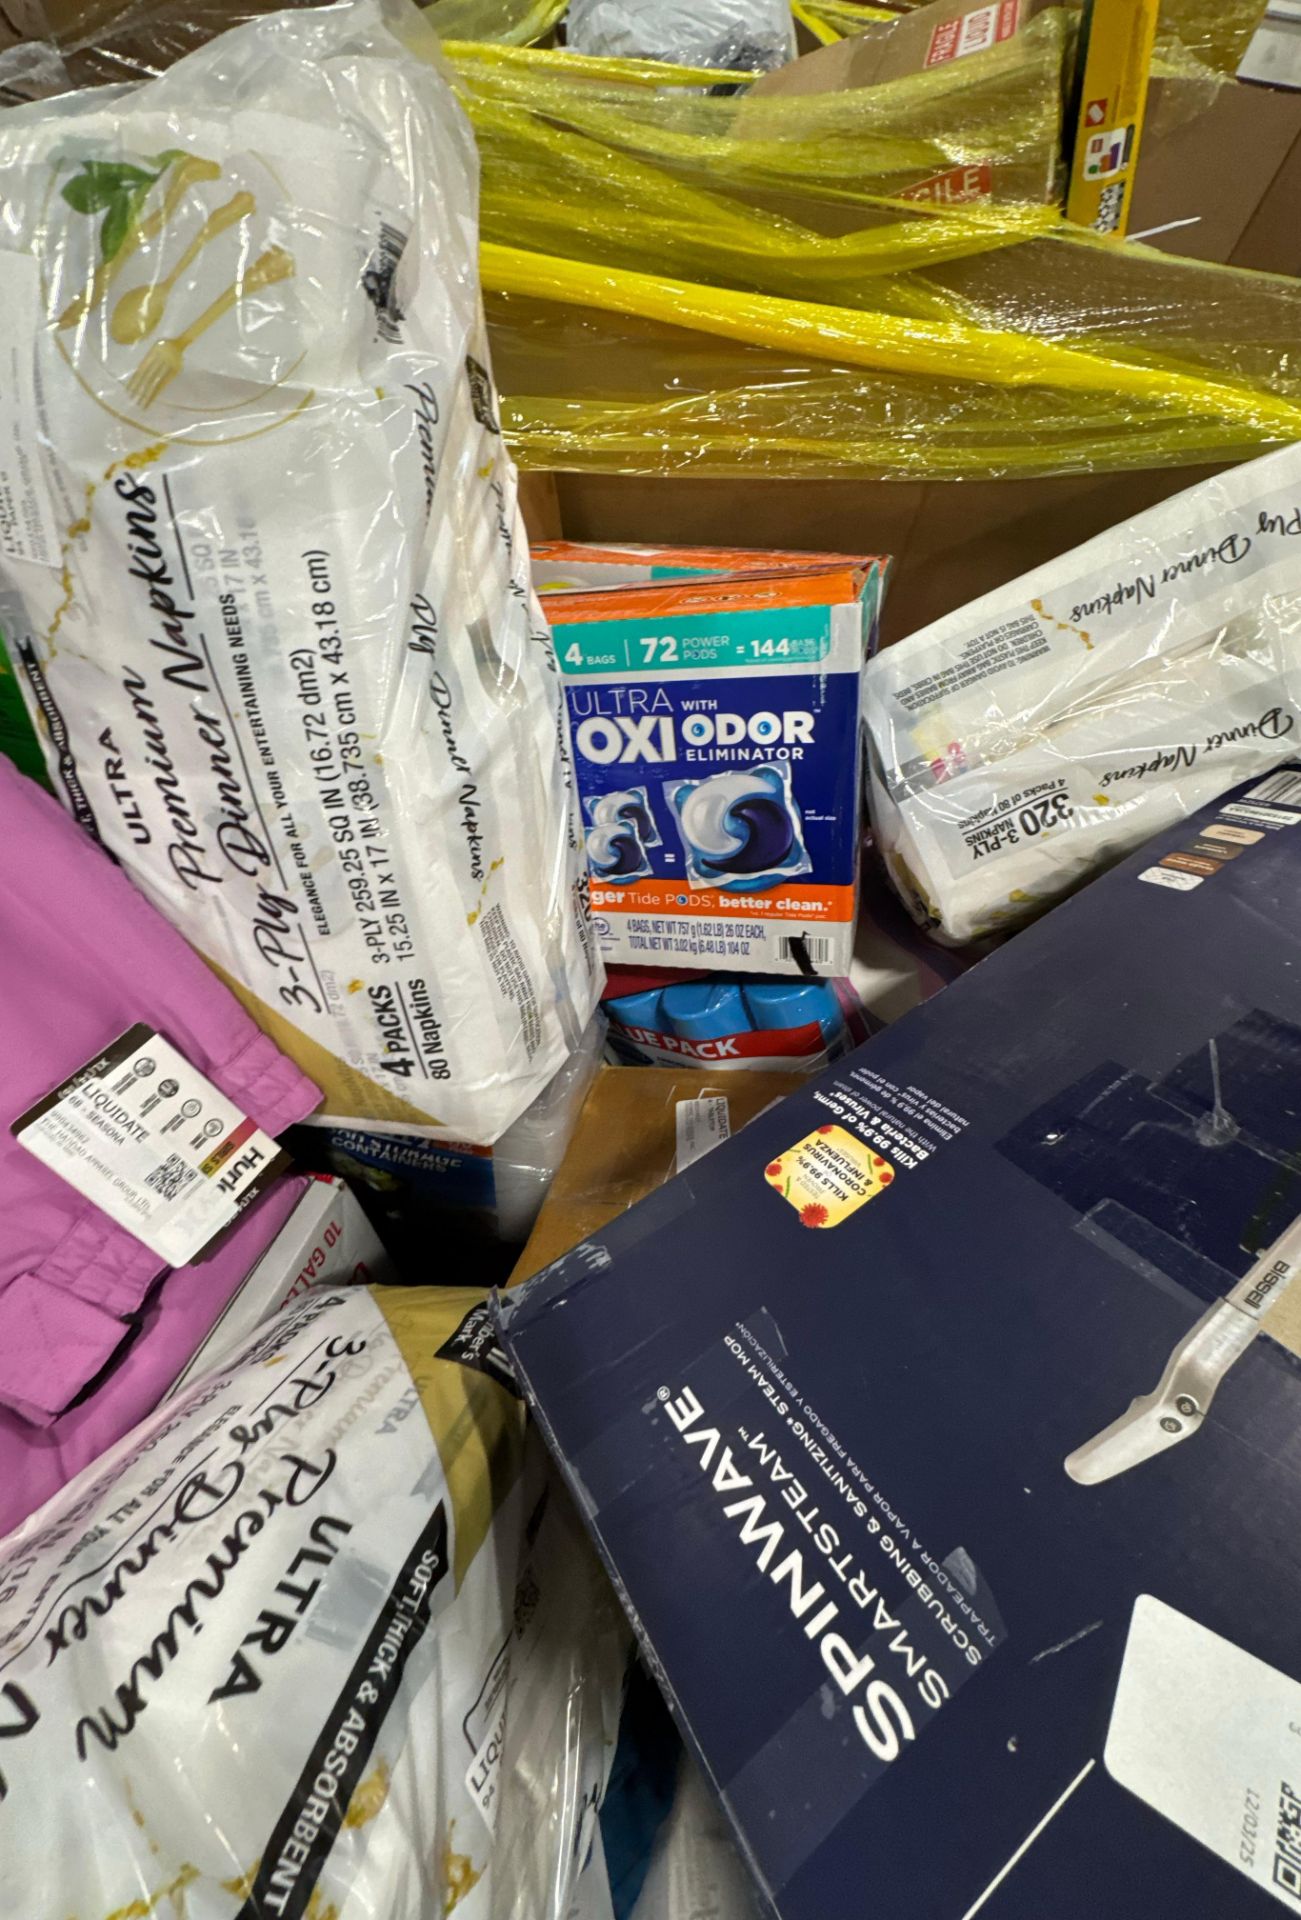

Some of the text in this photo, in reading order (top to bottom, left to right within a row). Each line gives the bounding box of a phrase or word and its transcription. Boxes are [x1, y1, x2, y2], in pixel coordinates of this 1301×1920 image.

[912, 166, 982, 205] GILE
[301, 549, 332, 594] cm)
[1161, 532, 1252, 586] Dinner
[1069, 574, 1157, 623] Napkins
[313, 602, 345, 667] 43.18
[563, 635, 731, 666] 4 BAGS 72 POWER
[682, 648, 719, 661] PODS
[750, 638, 791, 657] 144
[334, 691, 355, 725] cm
[572, 687, 719, 716] ULTRA WITH
[114, 472, 322, 1013] 3-Ply Dinner Napkins
[407, 593, 484, 882] Ply Dinner Napkins
[575, 715, 678, 765] OXI
[685, 746, 805, 762] ELIMINATOR
[1098, 705, 1295, 789] Dinner Napkins
[122, 665, 223, 890] Premium
[218, 592, 331, 936] ELEGANCE FOR ALL YOUR ENTERTAINING NEEDS
[337, 731, 378, 810] (38.735
[98, 726, 152, 845] ULTRA
[288, 648, 390, 963] 3-PLY 259.25 SQ IN (16.72 dm2)
[997, 778, 1065, 811] 4 Packs of 80
[359, 817, 380, 838] IN
[964, 817, 1014, 846] NAPKINS
[972, 792, 1074, 859] 320 3-PLY
[367, 847, 389, 867] 17
[378, 889, 400, 907] IN
[627, 892, 661, 906] Tide
[718, 894, 774, 911] better
[385, 912, 414, 961] 15.25
[627, 935, 647, 950] TOTAL
[648, 936, 661, 950] NET
[740, 941, 750, 955] OZ
[651, 919, 665, 934] NET
[665, 920, 676, 934] WT
[734, 923, 744, 938] OZ
[368, 984, 416, 1079] 4 PACKS
[408, 978, 451, 1081] 80 Napkins
[662, 1036, 741, 1059] PACK
[858, 1067, 879, 1079] poder
[884, 1081, 899, 1092] con
[81, 1082, 149, 1143] LIQUIDATE
[858, 1095, 882, 1112] power
[880, 1090, 891, 1098] de
[890, 1096, 898, 1104] %
[896, 1101, 916, 1115] 99.9
[906, 1085, 970, 1126] natural del vapor
[86, 1110, 125, 1145] SEASONA
[715, 1098, 728, 1139] LIQUIDATE
[813, 1090, 918, 1169] Kills 99.9% of Germs,
[869, 1115, 881, 1125] &
[878, 1109, 905, 1128] natural
[904, 1127, 918, 1138] the
[922, 1117, 953, 1140] Elimina
[924, 1107, 961, 1134] bacterias
[331, 1136, 447, 1173] CONTAINERS
[880, 1122, 929, 1160] Bacteria
[917, 1135, 936, 1152] With
[795, 1155, 848, 1201] KILLS 99.9%
[802, 1142, 866, 1196] CORONAVIRUS
[814, 1138, 873, 1186] & INFLUENZA
[322, 1220, 343, 1248] 10
[723, 1335, 756, 1367] MOP
[229, 1335, 367, 1456] 3-Ply
[751, 1363, 790, 1417] STEAM
[793, 1393, 806, 1406] Y
[803, 1404, 847, 1458] FREGADO
[846, 1457, 874, 1492] PARA
[106, 1468, 172, 1522] FOR ALL
[872, 1491, 909, 1539] VAPOR
[867, 1516, 881, 1534] &
[911, 1538, 922, 1549] A
[45, 1460, 245, 1668] Dinner
[75, 1448, 337, 1762] Premium
[207, 1514, 353, 1704] ULTRA
[879, 1536, 982, 1667] SCRUBBING
[920, 1551, 995, 1646] TRAPEADOR
[264, 1549, 438, 1916] SOFT, THICK & ABSORBENT
[1239, 1787, 1261, 1868] 12/03/25
